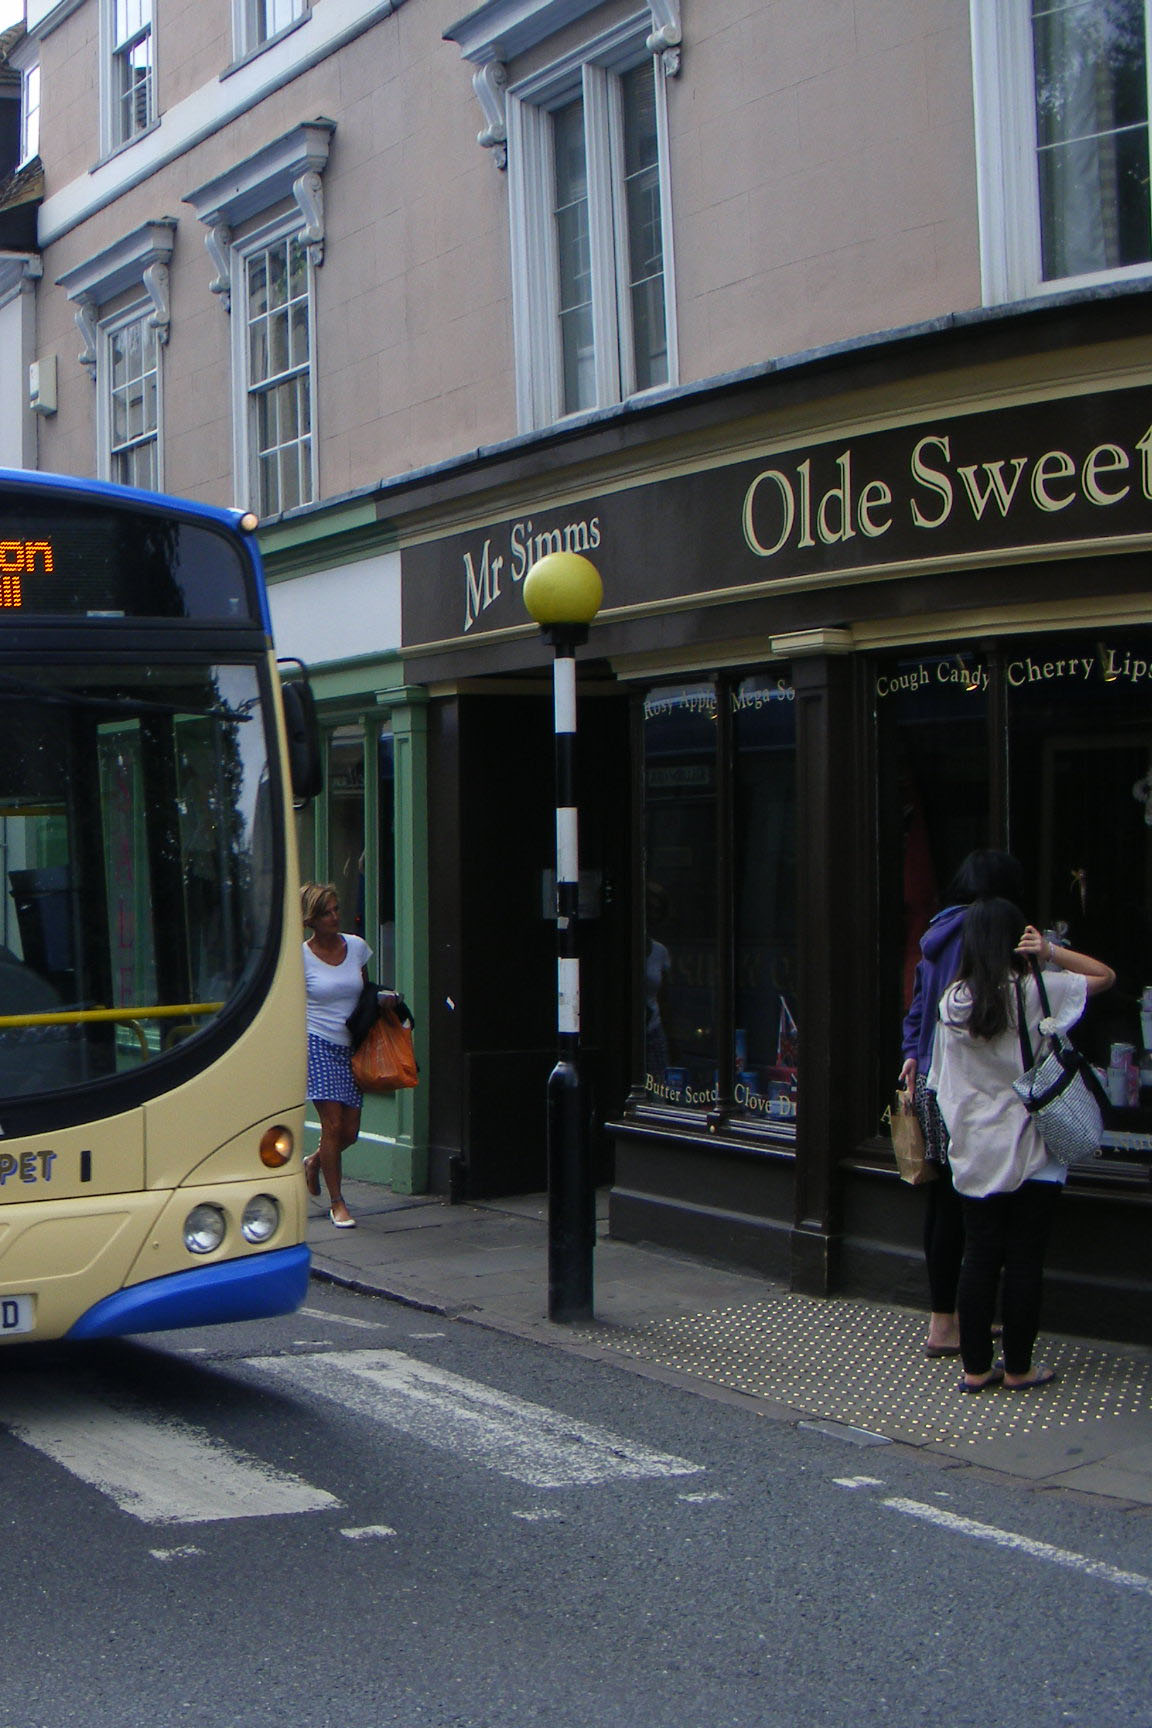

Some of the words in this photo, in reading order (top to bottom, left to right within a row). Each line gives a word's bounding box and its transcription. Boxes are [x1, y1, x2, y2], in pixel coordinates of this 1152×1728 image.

[463, 539, 504, 632] Mr
[510, 516, 601, 582] Simms
[741, 449, 893, 557] Olde
[876, 664, 930, 697] Cough
[936, 661, 991, 692] Candy
[1006, 657, 1095, 688] Cherry
[643, 700, 674, 721] Rosy
[730, 688, 770, 713] Mega
[644, 1072, 681, 1102] Butter
[733, 1083, 772, 1115] Clove
